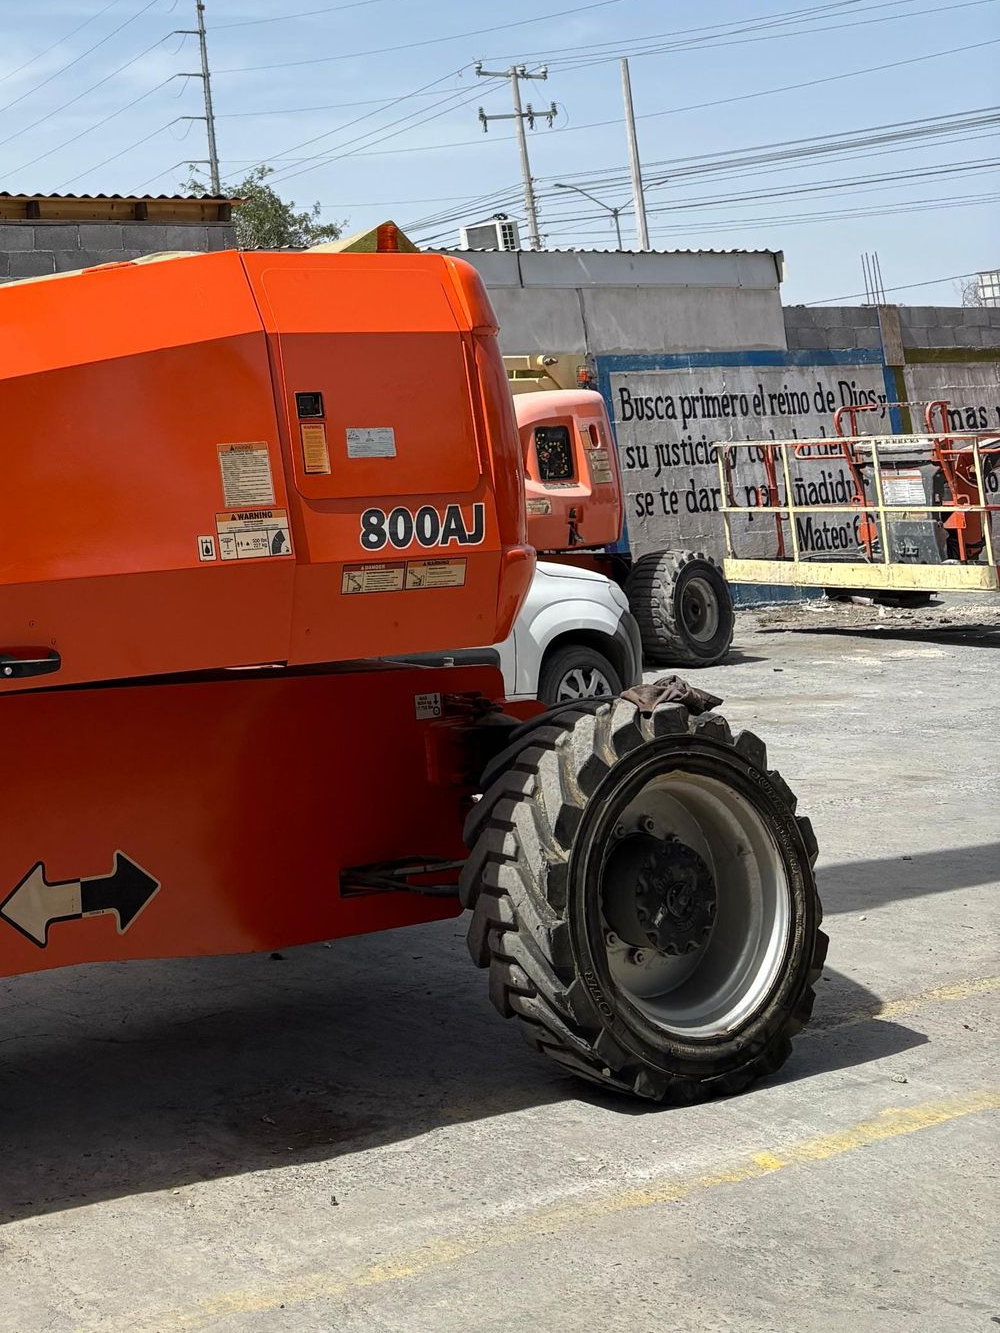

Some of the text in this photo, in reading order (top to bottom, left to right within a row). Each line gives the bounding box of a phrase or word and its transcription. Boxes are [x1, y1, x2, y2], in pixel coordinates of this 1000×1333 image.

[618, 387, 678, 422] Busca
[679, 387, 747, 430] primero
[753, 384, 766, 415] el
[769, 385, 810, 415] reino
[813, 382, 835, 413] de
[837, 380, 876, 413] Dios
[626, 444, 649, 469] su
[654, 435, 720, 477] justicia
[239, 511, 273, 520] WARNING
[635, 489, 654, 517] se
[660, 486, 678, 514] te
[686, 478, 721, 513] dar
[360, 503, 485, 551] 800AJ
